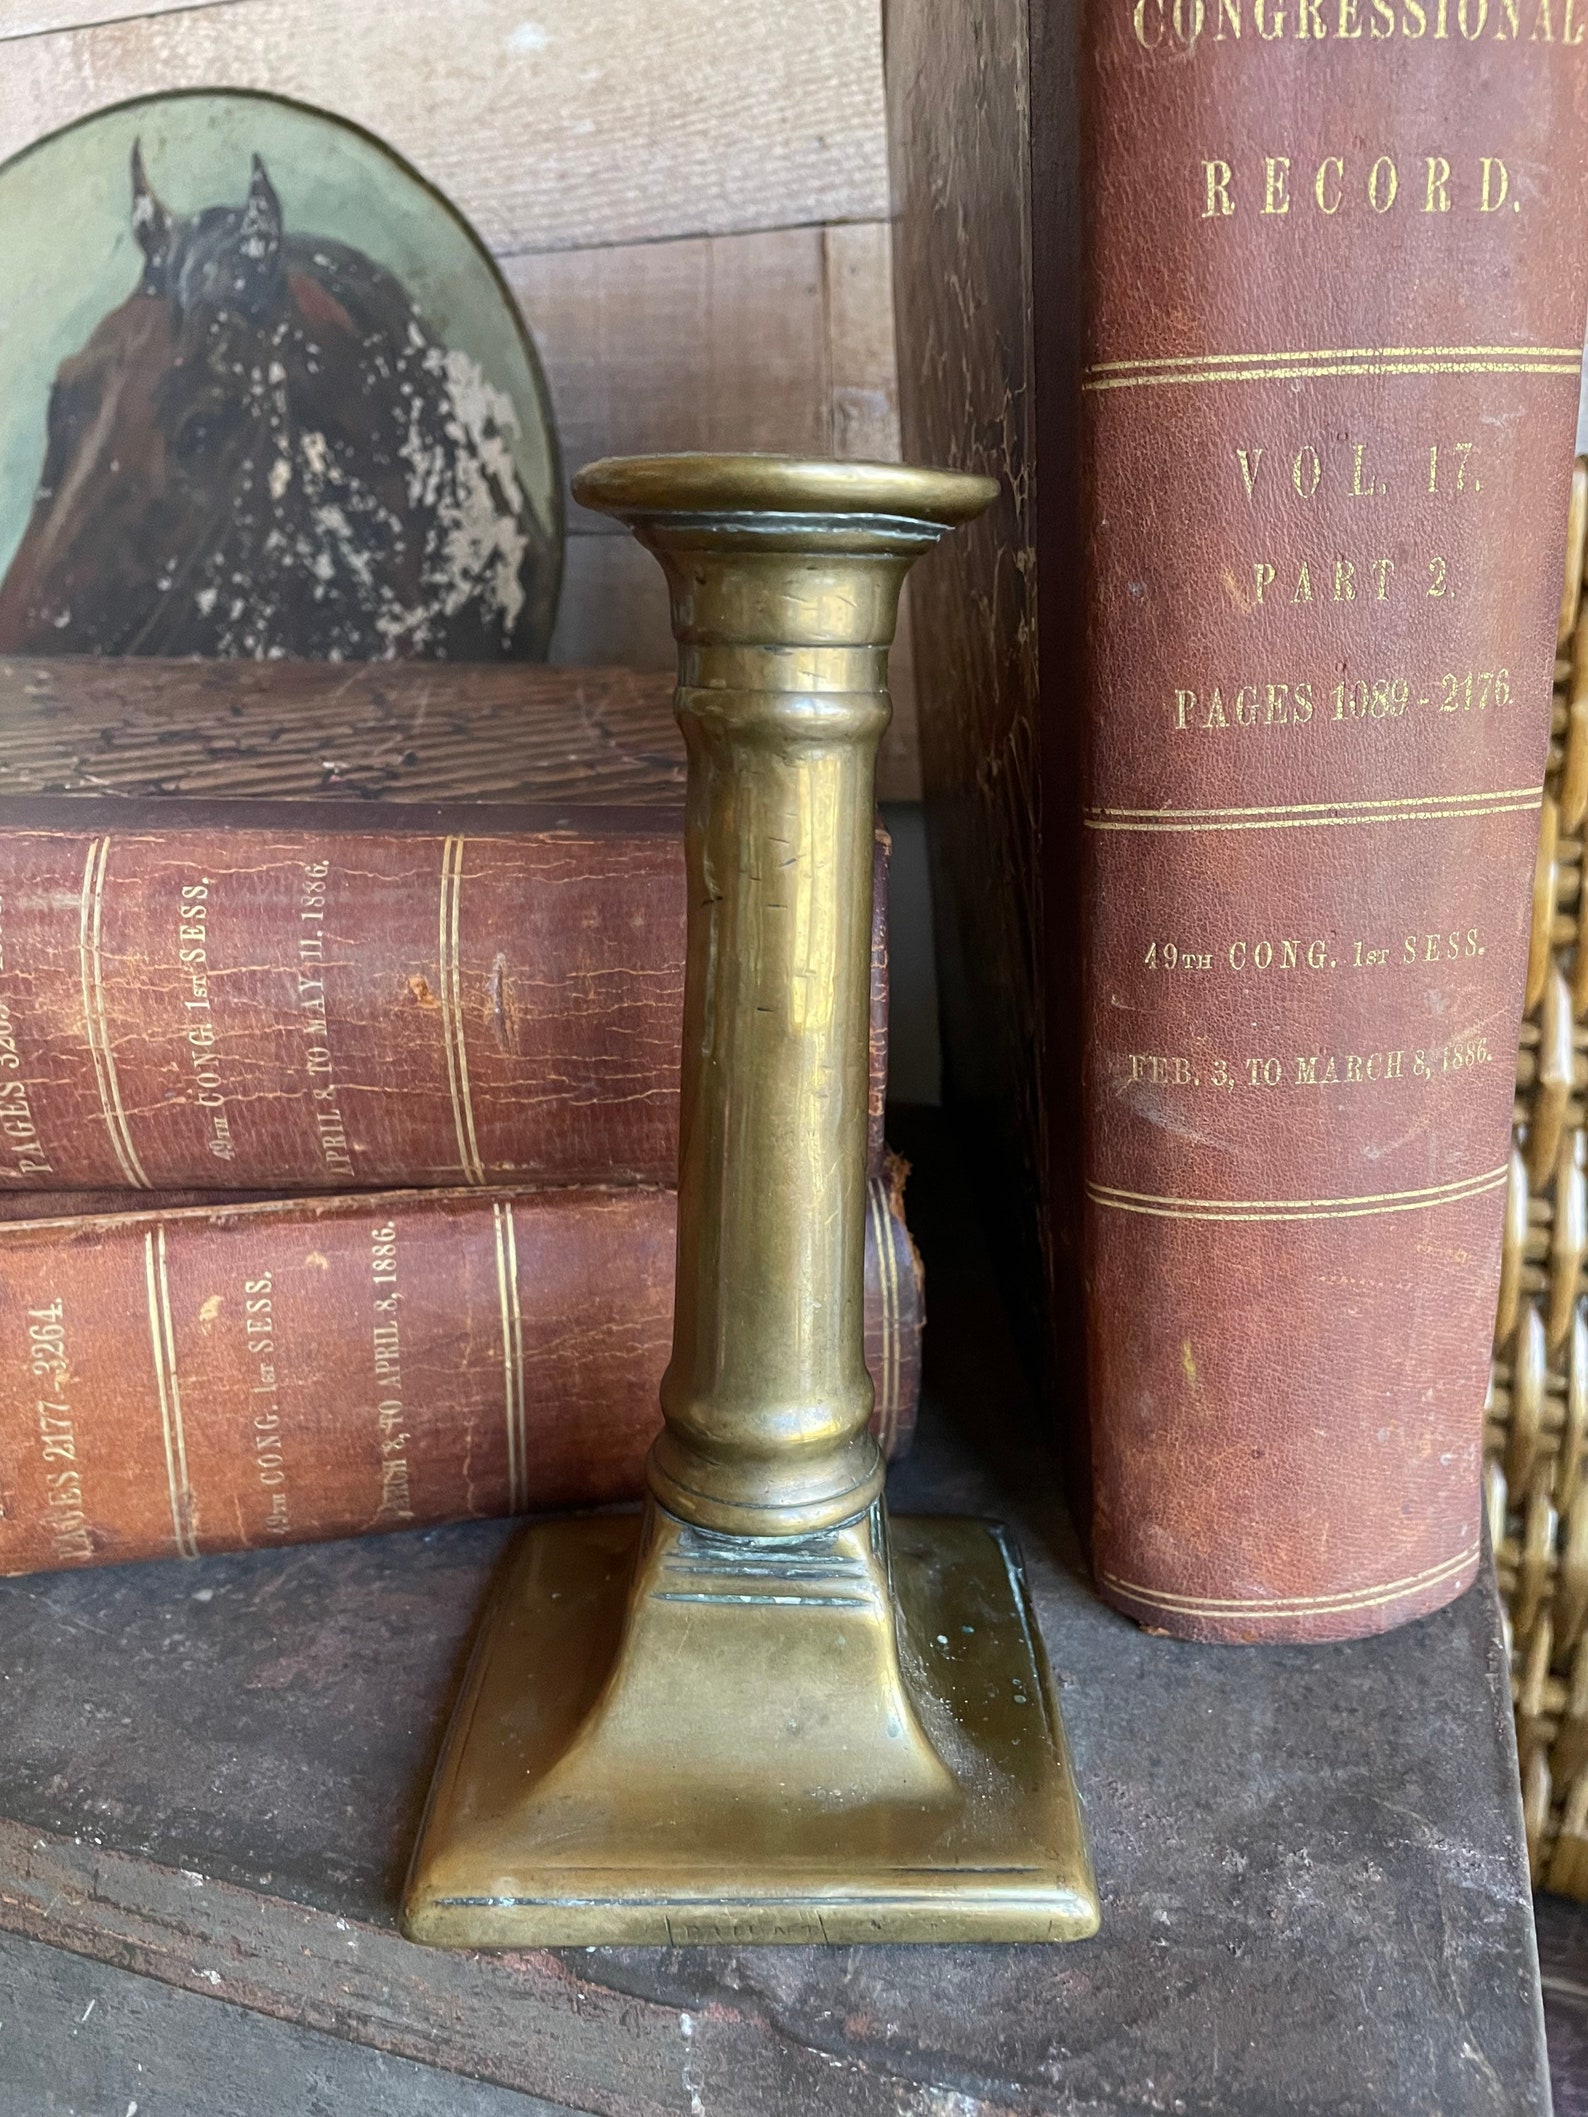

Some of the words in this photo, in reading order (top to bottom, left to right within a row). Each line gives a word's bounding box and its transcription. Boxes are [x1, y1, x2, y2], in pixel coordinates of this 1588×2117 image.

[1201, 156, 1520, 218] RECORD.
[1236, 443, 1387, 499] VOL.
[1428, 442, 1483, 493] 17.
[1253, 558, 1395, 604] PART
[1426, 556, 1456, 598] 2.
[1174, 682, 1314, 729] PAGES
[179, 877, 209, 963] SESS.
[301, 860, 330, 921] 1886.
[1229, 940, 1337, 971] CONG.
[1403, 928, 1486, 965] SESS.
[299, 976, 328, 1036] MAY
[188, 1023, 225, 1107] CONG.
[306, 1047, 332, 1076] TO
[1128, 1053, 1200, 1087] FEB.
[1211, 1059, 1235, 1093] 3,
[1246, 1057, 1283, 1087] TO
[1295, 1050, 1404, 1085] MARCH
[1413, 1049, 1431, 1080] 8,
[1441, 1037, 1493, 1073] 1886.
[317, 1108, 355, 1177] APRIL
[371, 1221, 398, 1284] 1886.
[245, 1271, 274, 1353] SESS.
[373, 1291, 405, 1311] 8,
[372, 1320, 402, 1390] APRIL
[253, 1405, 286, 1485] CONG.
[378, 1400, 404, 1430] TO
